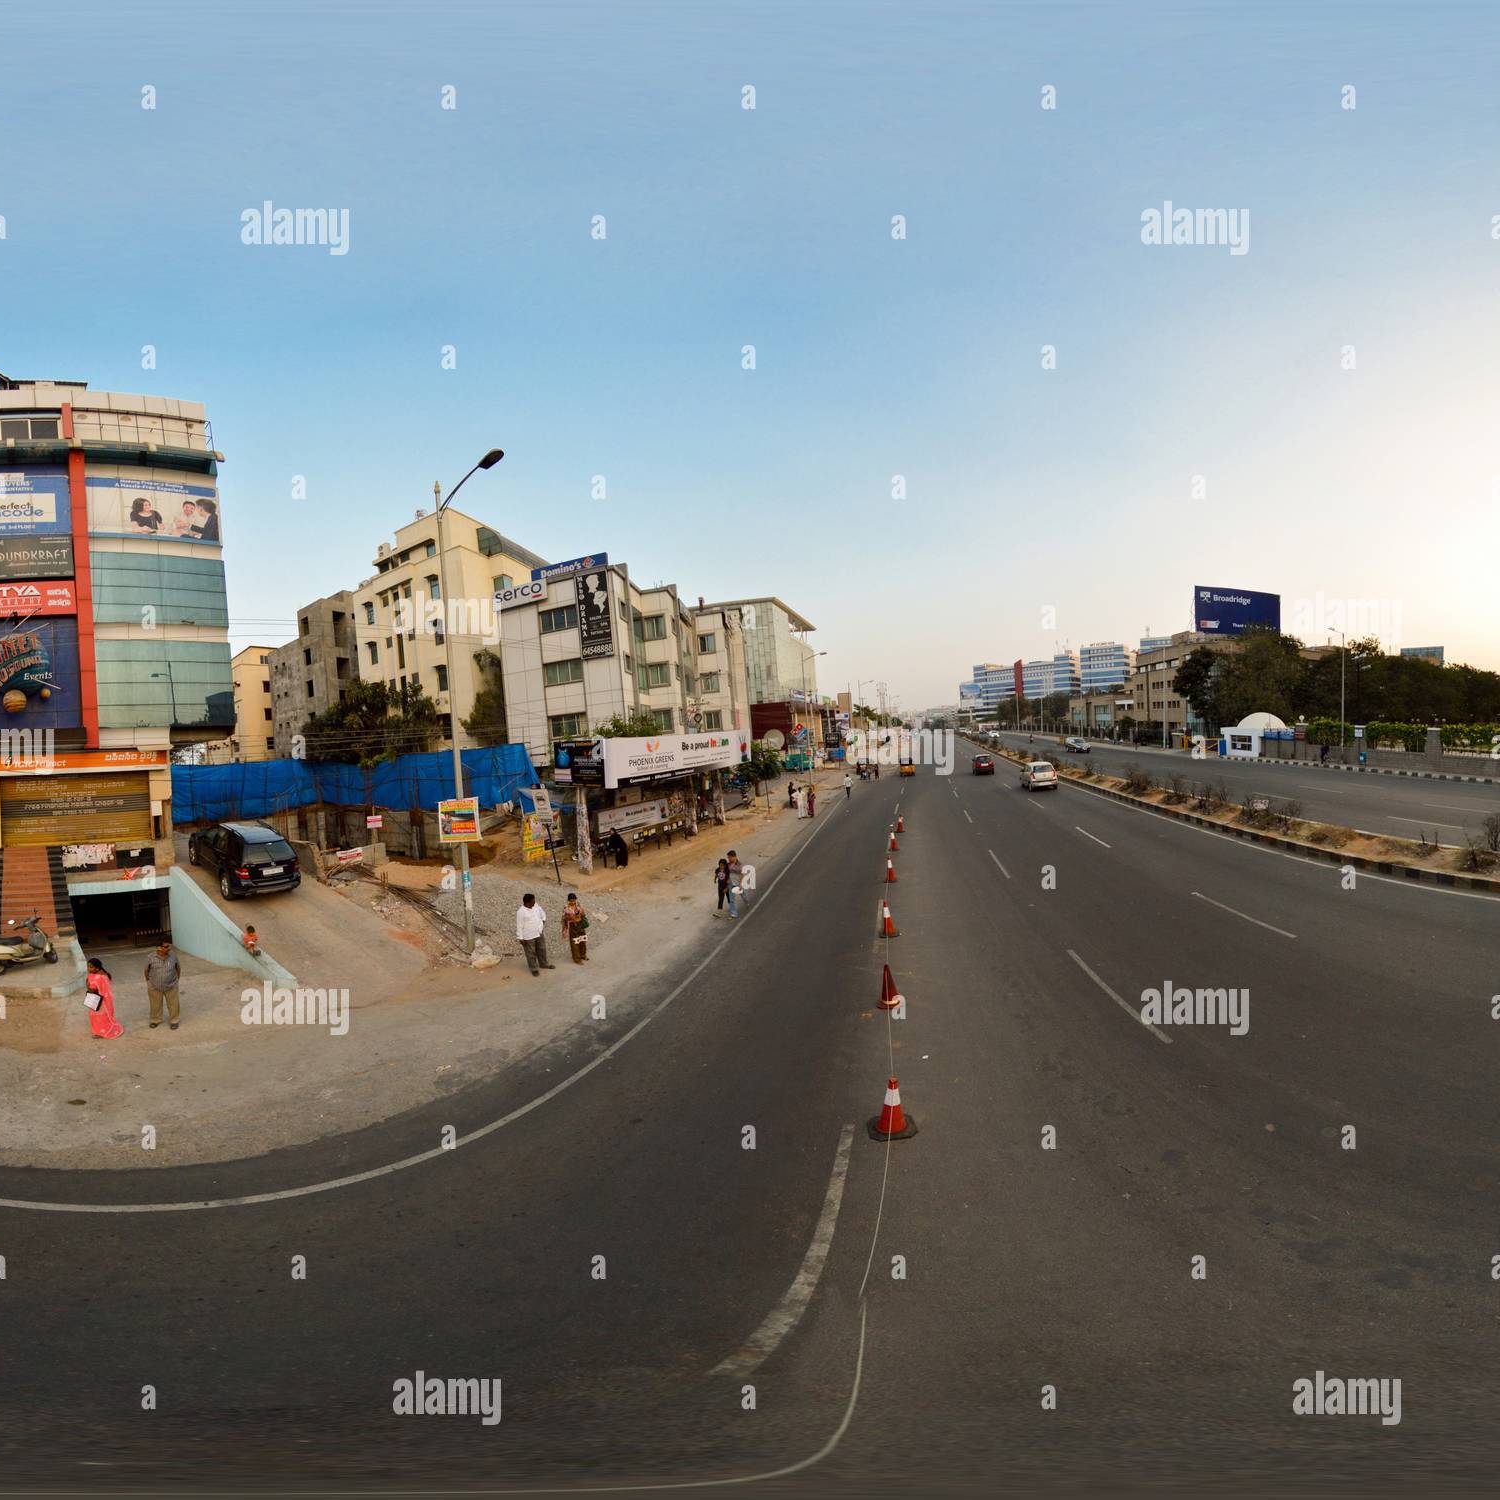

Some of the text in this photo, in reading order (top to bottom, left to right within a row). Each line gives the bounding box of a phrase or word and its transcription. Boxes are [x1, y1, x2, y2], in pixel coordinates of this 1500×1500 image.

[540, 562, 581, 578] Domino's
[495, 582, 542, 604] serco
[1213, 594, 1251, 605] Broadridge
[580, 604, 588, 638] DRAMA
[24, 671, 53, 681] Events
[681, 742, 690, 751] Be
[694, 740, 709, 751] proud
[628, 756, 654, 767] PHOENIX
[655, 754, 675, 764] GREENS
